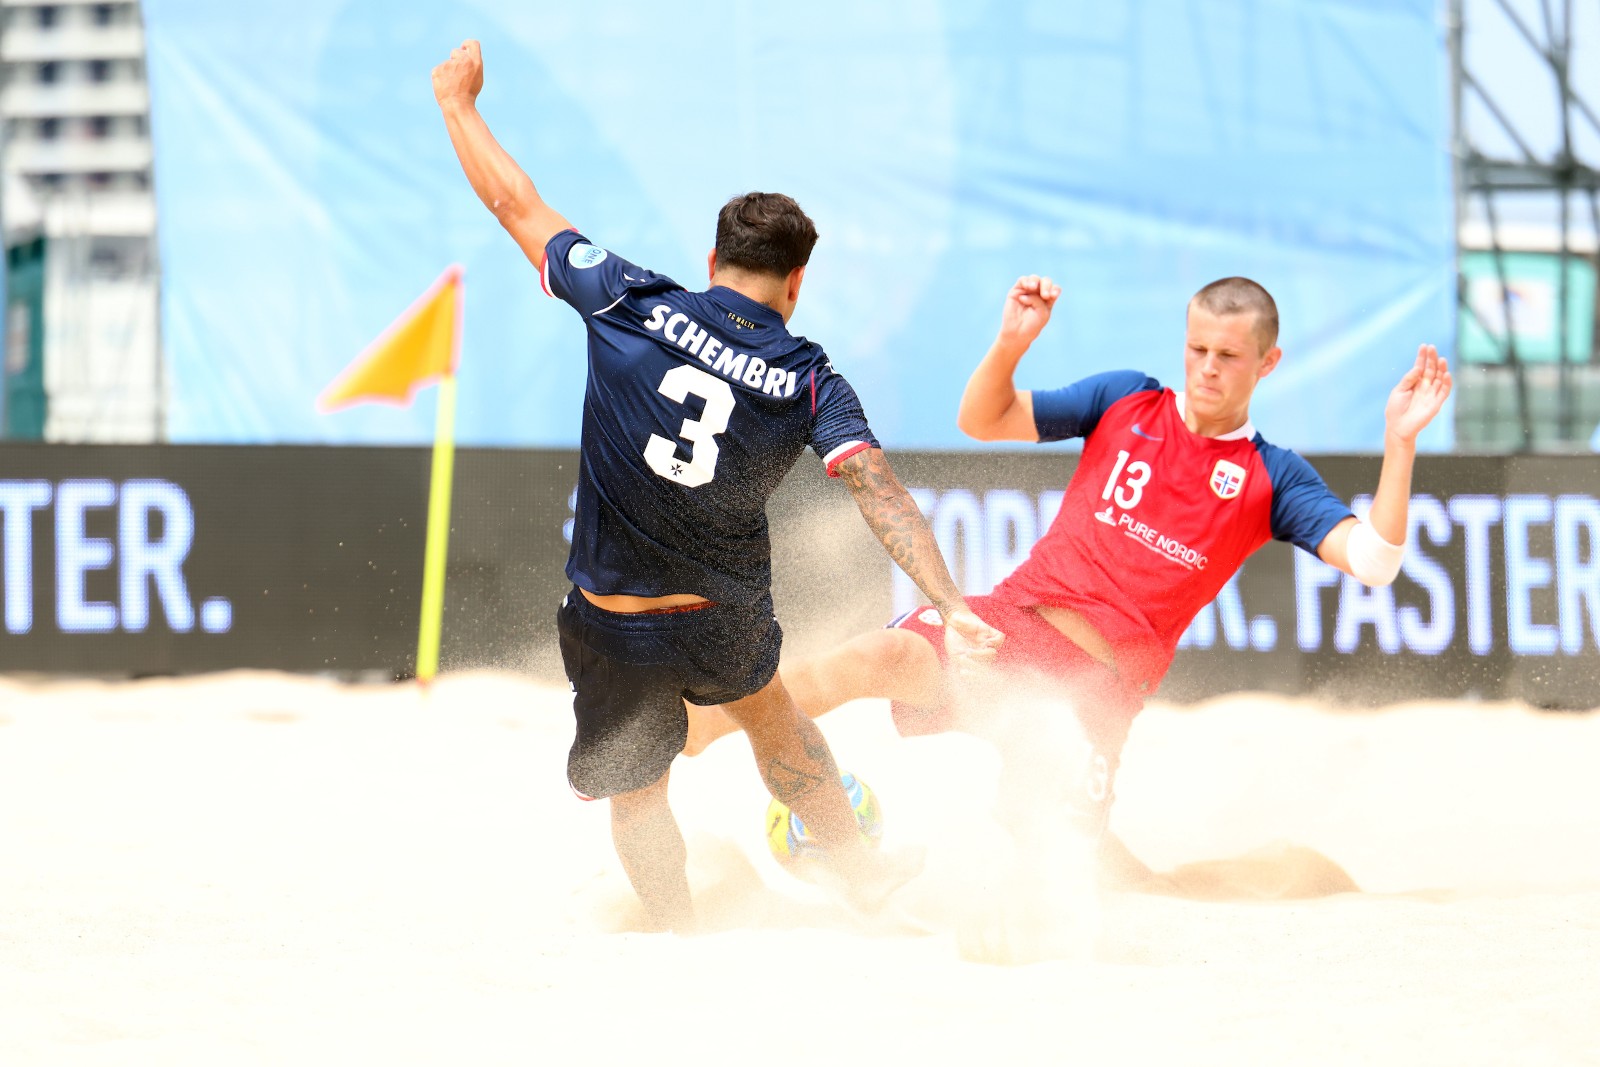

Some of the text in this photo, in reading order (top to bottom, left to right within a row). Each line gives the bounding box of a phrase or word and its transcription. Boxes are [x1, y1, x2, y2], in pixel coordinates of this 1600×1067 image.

[584, 248, 602, 265] ONE
[727, 312, 755, 330] FC MALTA
[644, 304, 798, 398] SCHEMBRI
[643, 364, 737, 488] 3
[1101, 450, 1152, 510] 13
[1118, 513, 1157, 543] PURE
[1155, 534, 1208, 570] NORDIC
